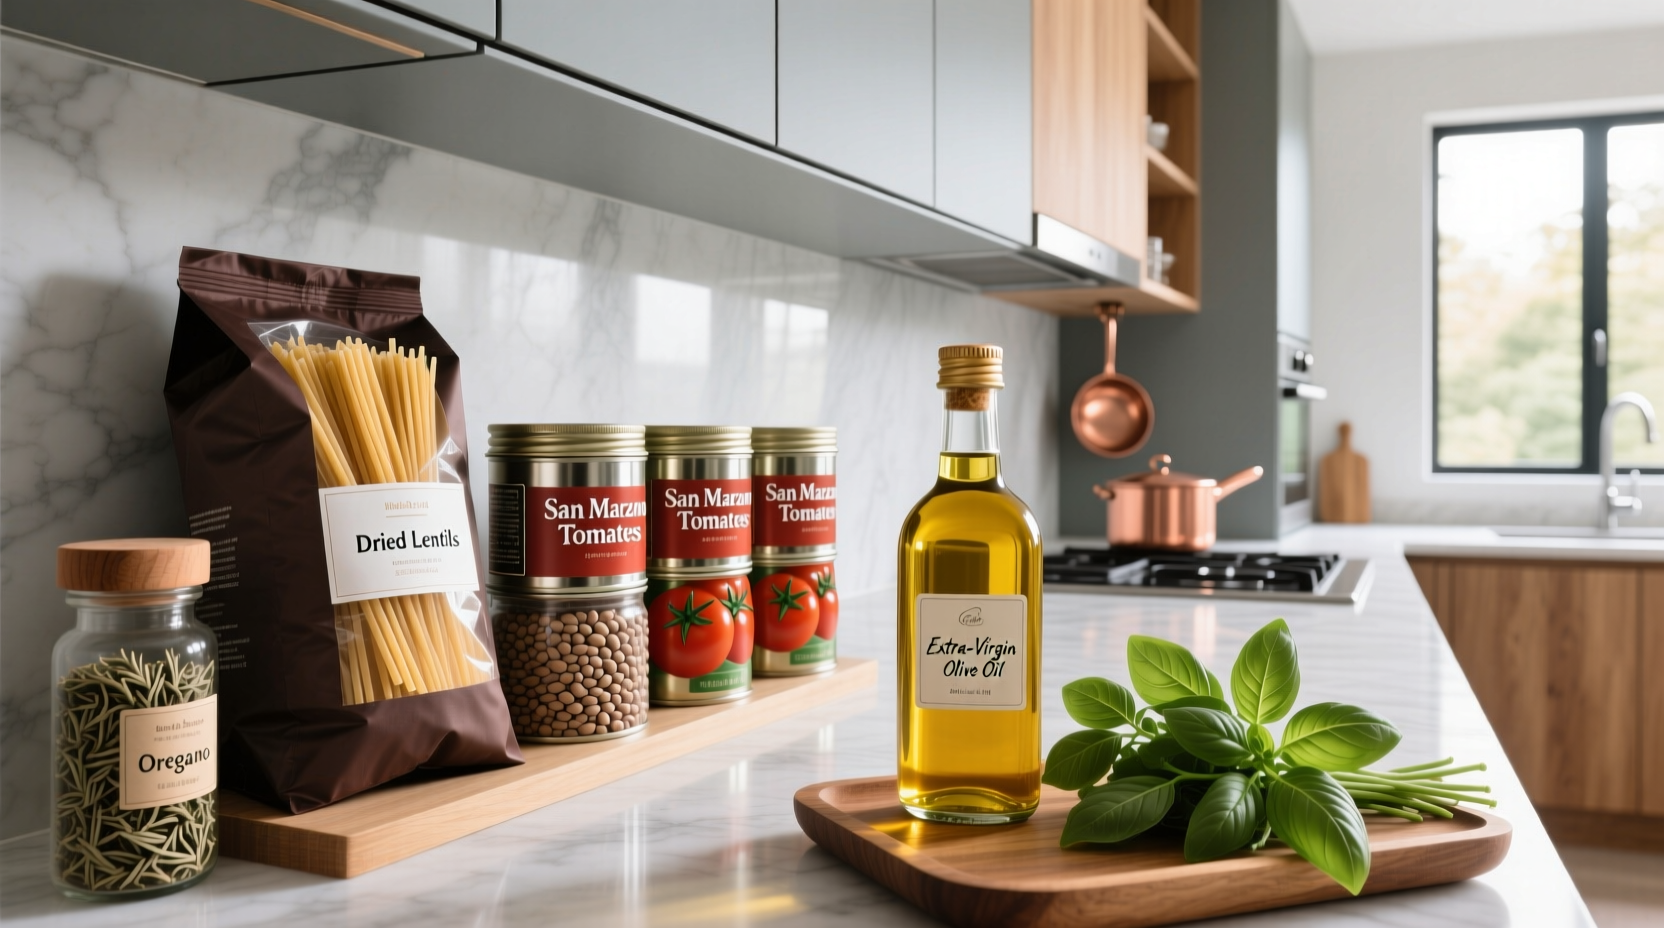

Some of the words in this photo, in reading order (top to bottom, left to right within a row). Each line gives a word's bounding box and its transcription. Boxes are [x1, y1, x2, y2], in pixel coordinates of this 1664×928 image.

[664, 488, 700, 508] San
[765, 483, 797, 501] San
[544, 498, 585, 520] San
[356, 530, 407, 553] Dried
[411, 529, 460, 549] Lentils
[558, 524, 642, 546] Tomates
[926, 636, 1016, 661] Extra-Virgin
[943, 659, 978, 677] Olive
[982, 660, 1006, 677] Oil
[138, 747, 211, 774] Oregano
